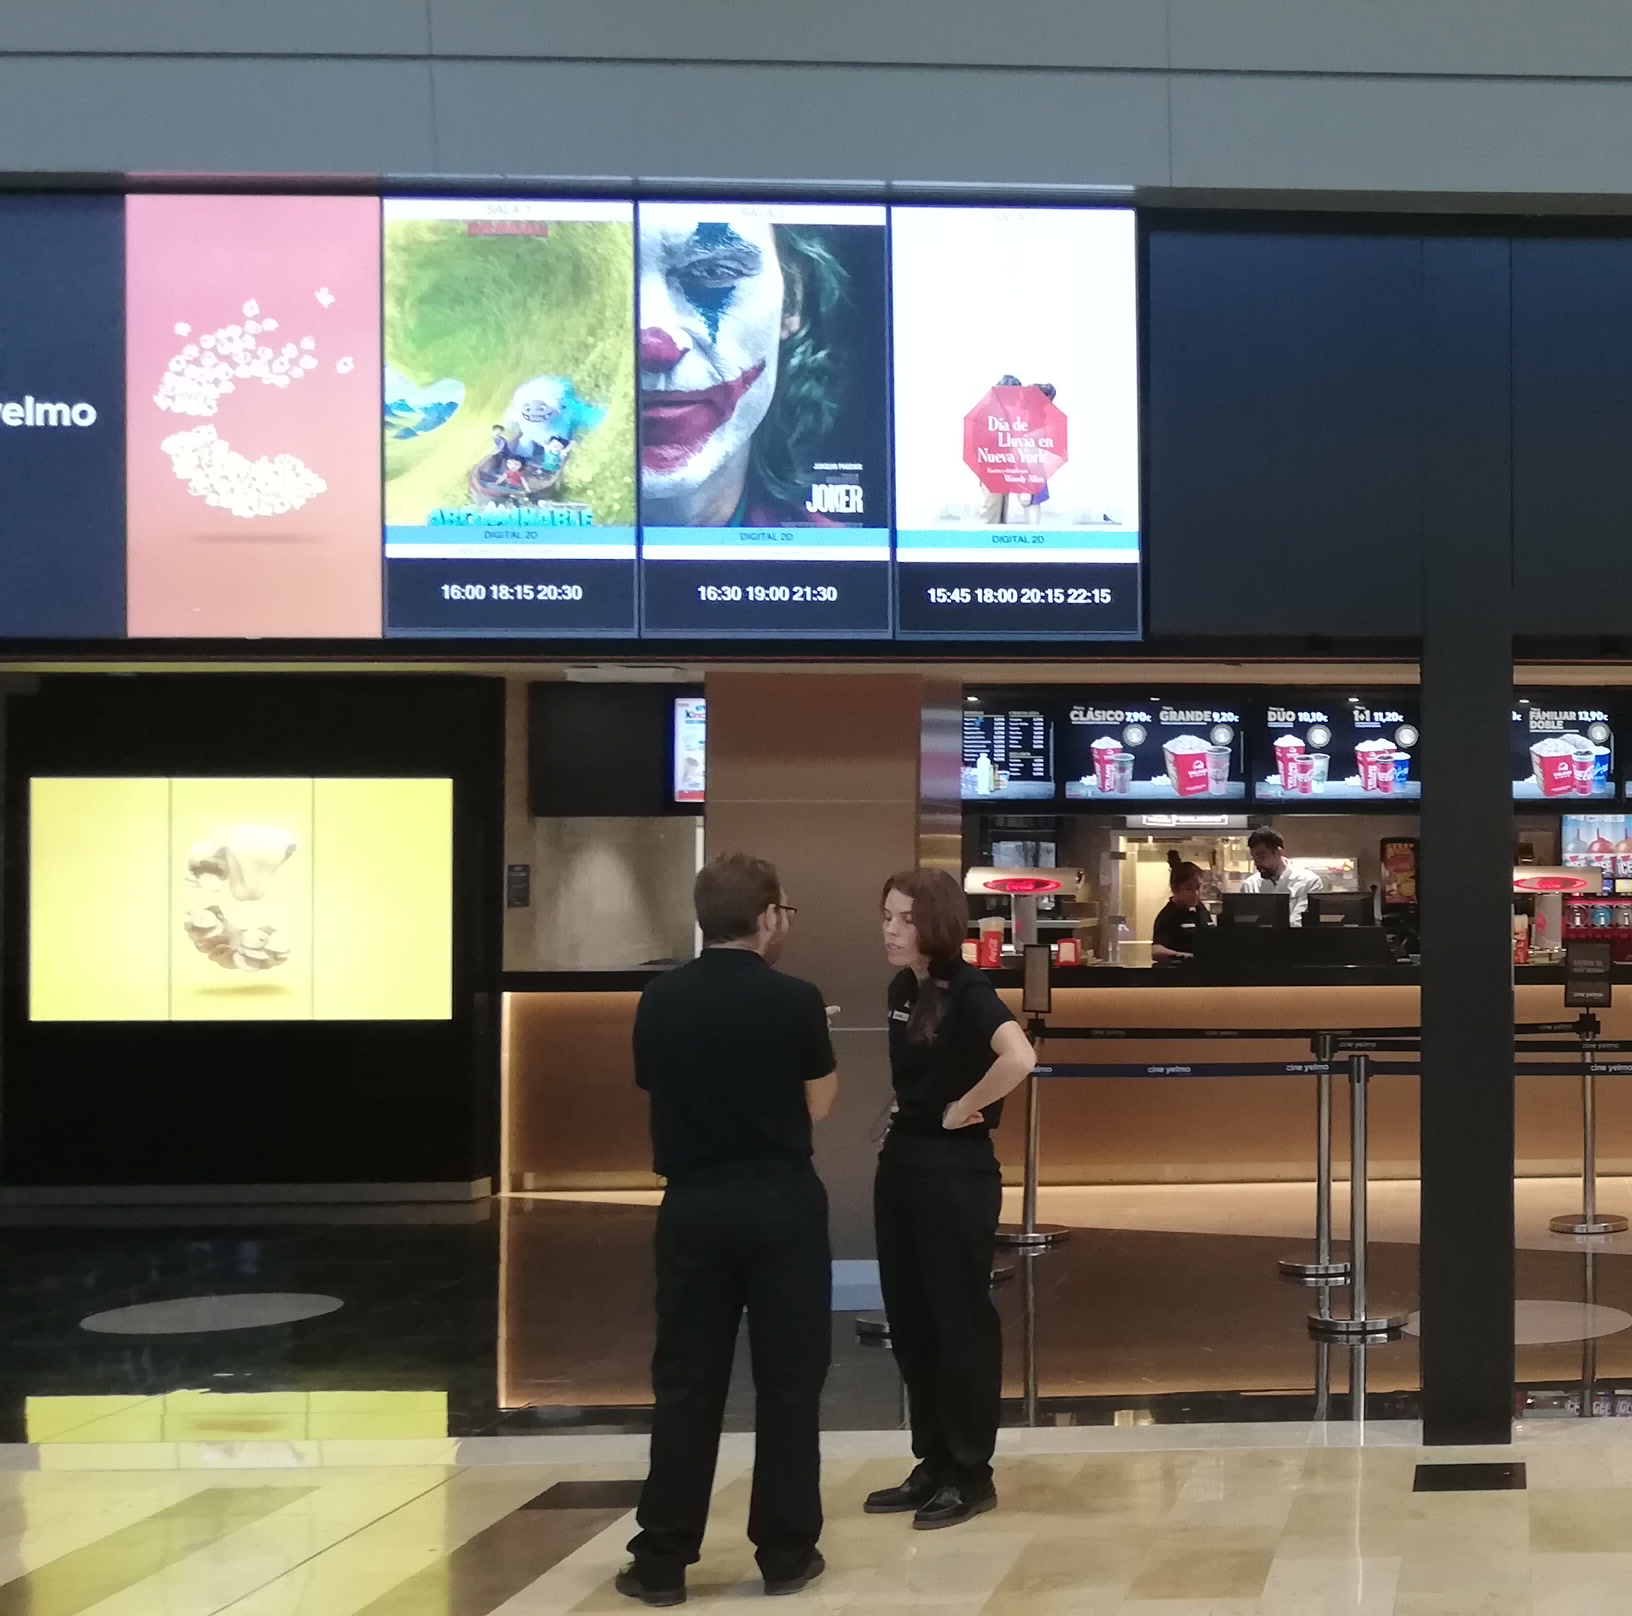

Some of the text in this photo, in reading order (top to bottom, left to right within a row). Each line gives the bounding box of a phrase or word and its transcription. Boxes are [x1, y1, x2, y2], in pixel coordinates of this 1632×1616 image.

[0, 394, 97, 427] elmo
[987, 415, 1029, 431] Día de
[998, 431, 1054, 448] Lluvia en
[977, 447, 1048, 463] Nueva York
[805, 483, 864, 513] JOKER
[484, 530, 521, 540] DIGITAL
[739, 532, 794, 542] DIGITAL 2D
[992, 535, 1045, 544] DIGITAL 2D
[441, 584, 583, 600] 16:00 18:15 20:30
[698, 586, 838, 601] 16:30 19:00 21:30
[928, 588, 1112, 604] 15:45 18:00 20:15 22:15
[1069, 707, 1124, 722] CLÁSICO
[1159, 710, 1211, 722] GRANDE
[1529, 710, 1577, 721] FAMILIAR
[1529, 720, 1565, 729] DOBLE
[1147, 1065, 1191, 1074] cine yelmo
[1304, 1063, 1330, 1072] yelmo
[1608, 1064, 1632, 1072] yelmo
